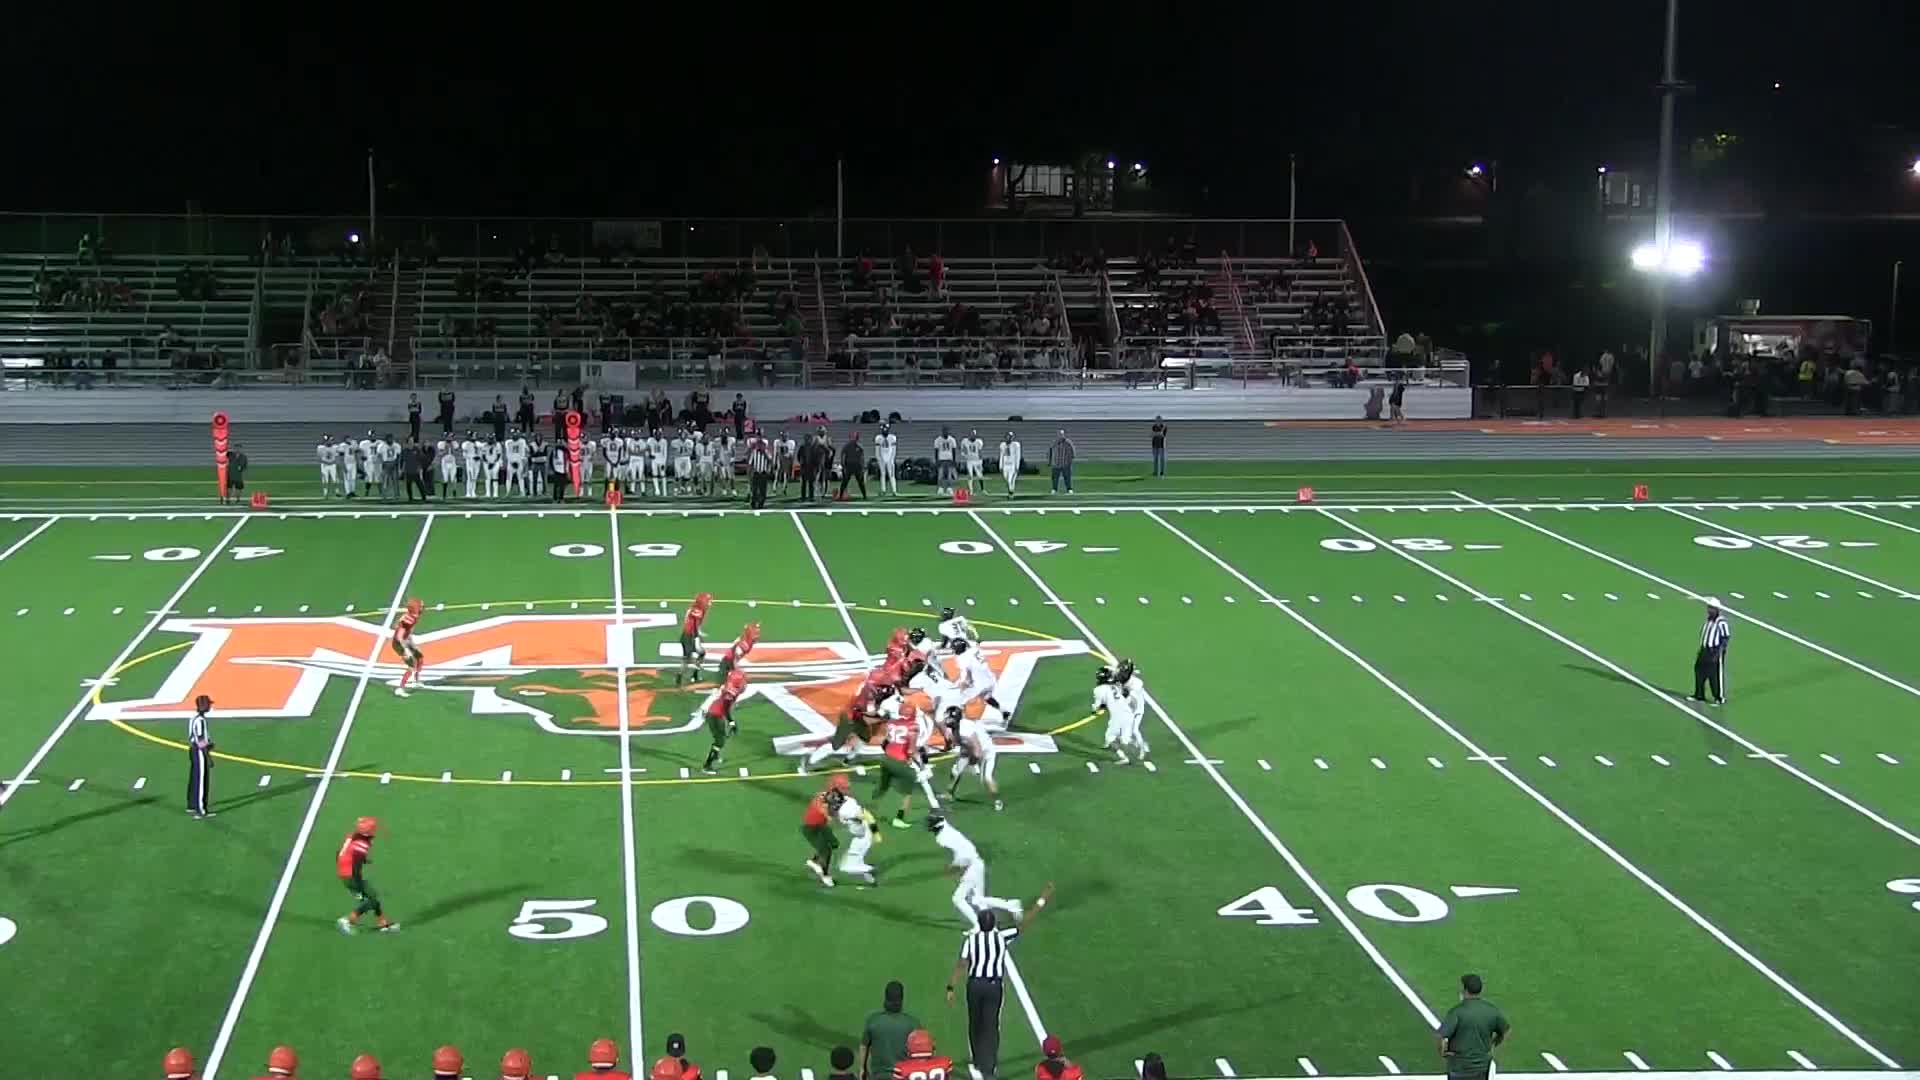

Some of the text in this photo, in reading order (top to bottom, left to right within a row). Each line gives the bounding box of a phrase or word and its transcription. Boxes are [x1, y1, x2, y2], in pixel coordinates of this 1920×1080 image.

[937, 540, 1069, 555] 40
[1319, 537, 1454, 552] 30
[1693, 534, 1829, 549] 20
[143, 546, 285, 562] 40
[549, 543, 683, 558] 50
[1216, 884, 1450, 926] 40
[507, 895, 750, 939] 50
